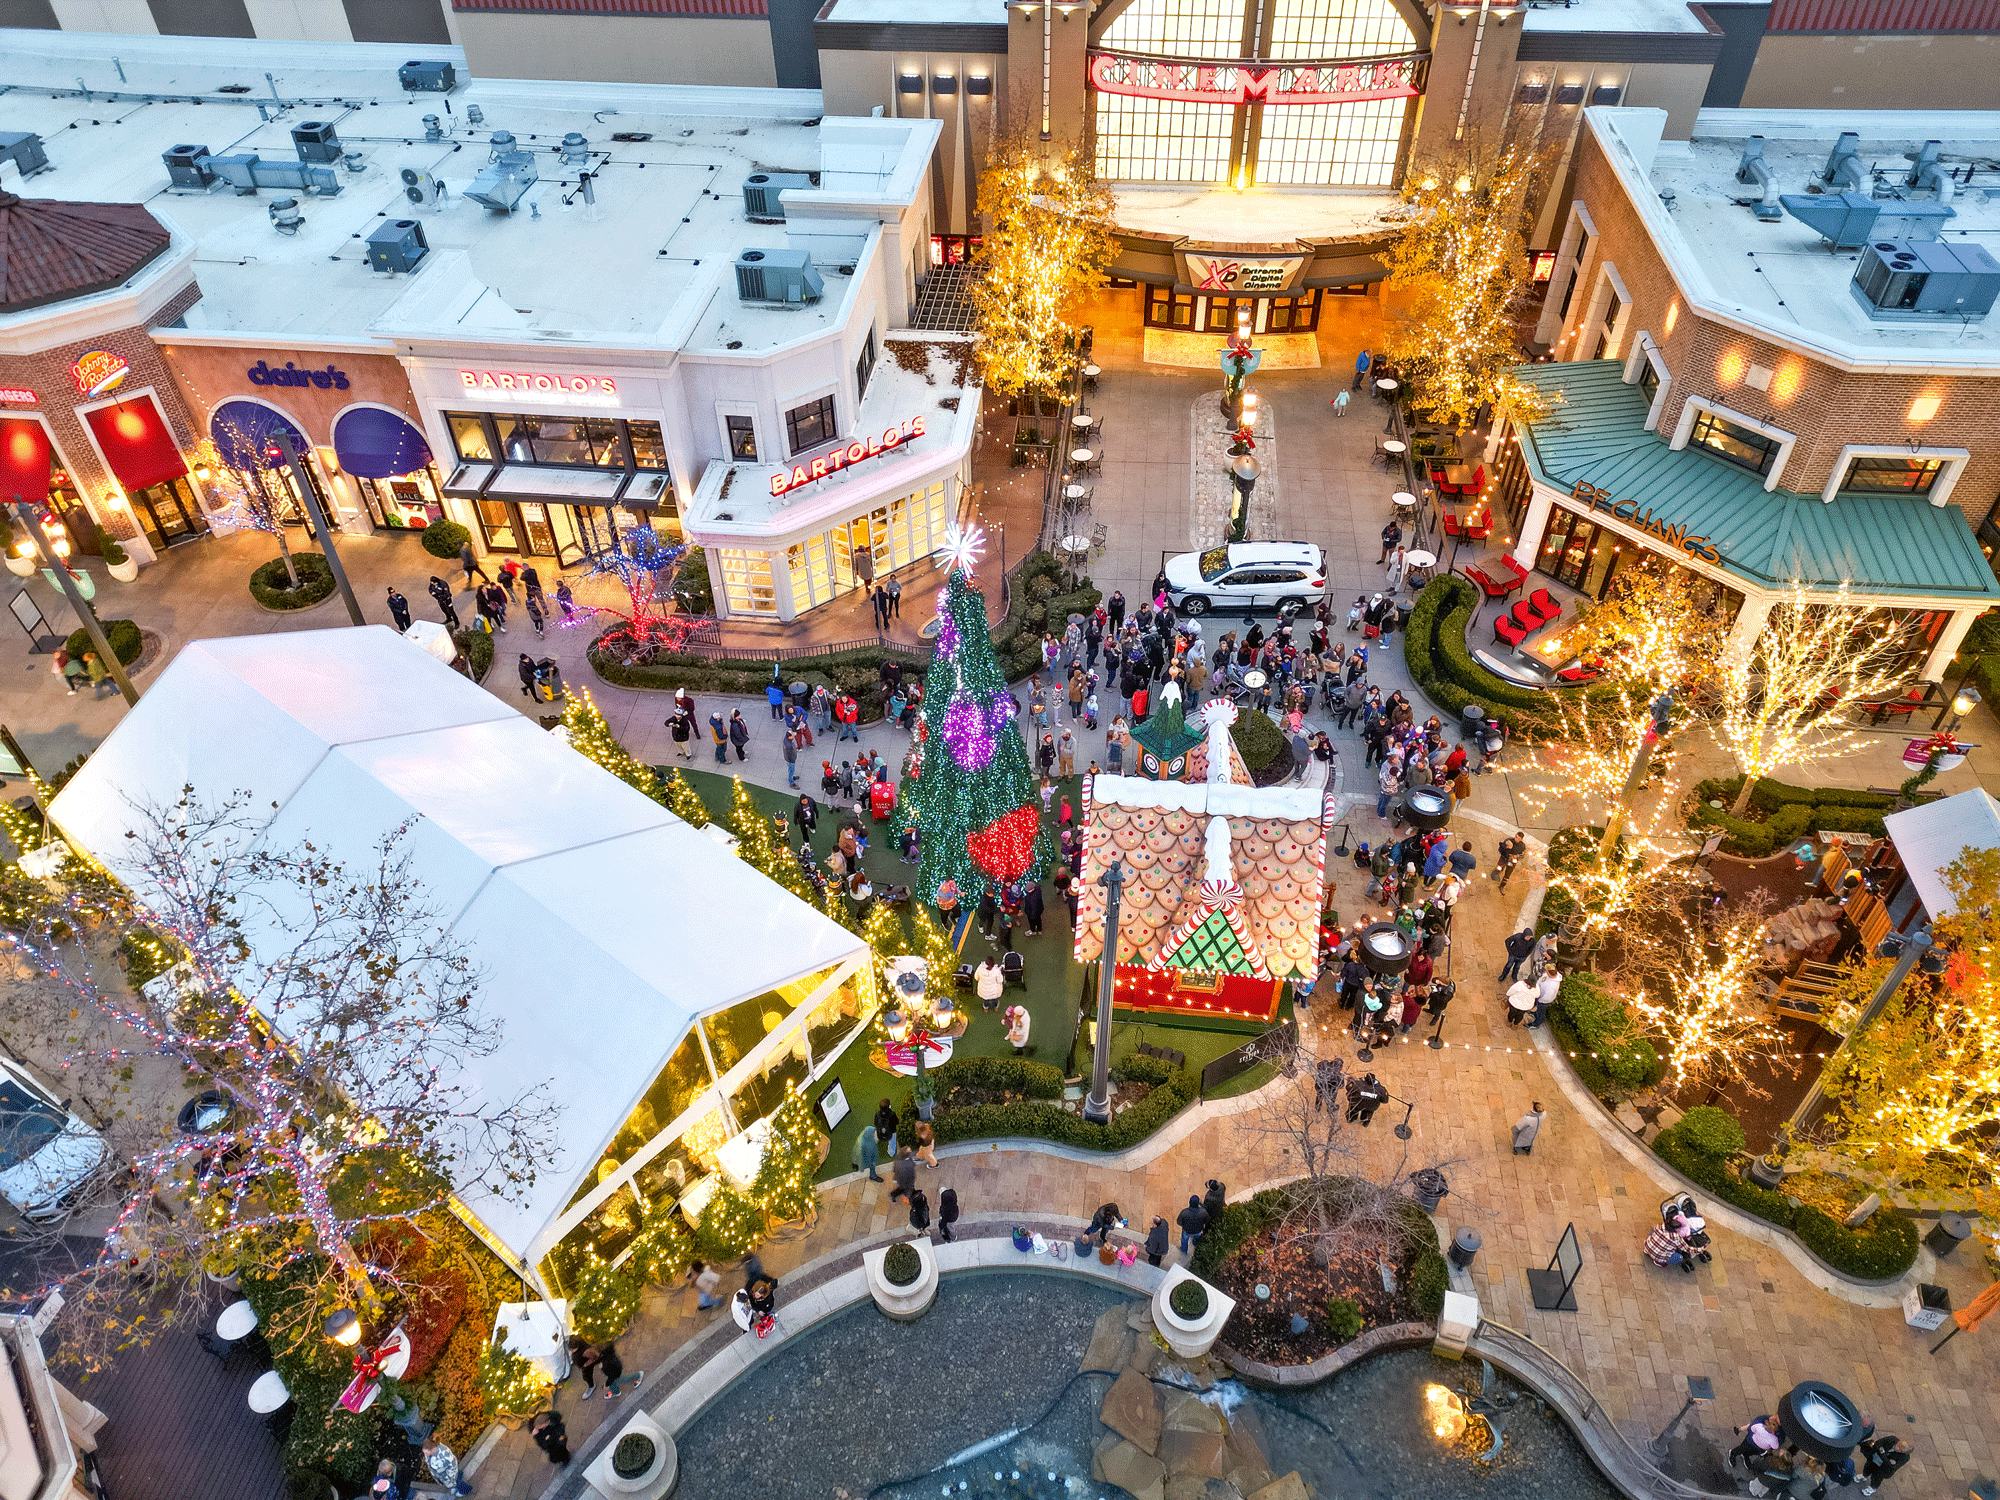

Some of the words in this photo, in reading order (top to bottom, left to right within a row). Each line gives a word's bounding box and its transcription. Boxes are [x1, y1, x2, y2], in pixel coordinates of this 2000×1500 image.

[1091, 54, 1420, 105] CINEMARK
[1244, 281, 1281, 289] Cinema
[1251, 275, 1284, 283] Digital
[73, 352, 112, 391] Johnny
[85, 358, 125, 389] Rockets
[248, 360, 350, 390] claire's
[460, 371, 617, 395] BARTOLO'S
[771, 415, 926, 496] BARTOLO'S
[396, 492, 419, 500] SALE
